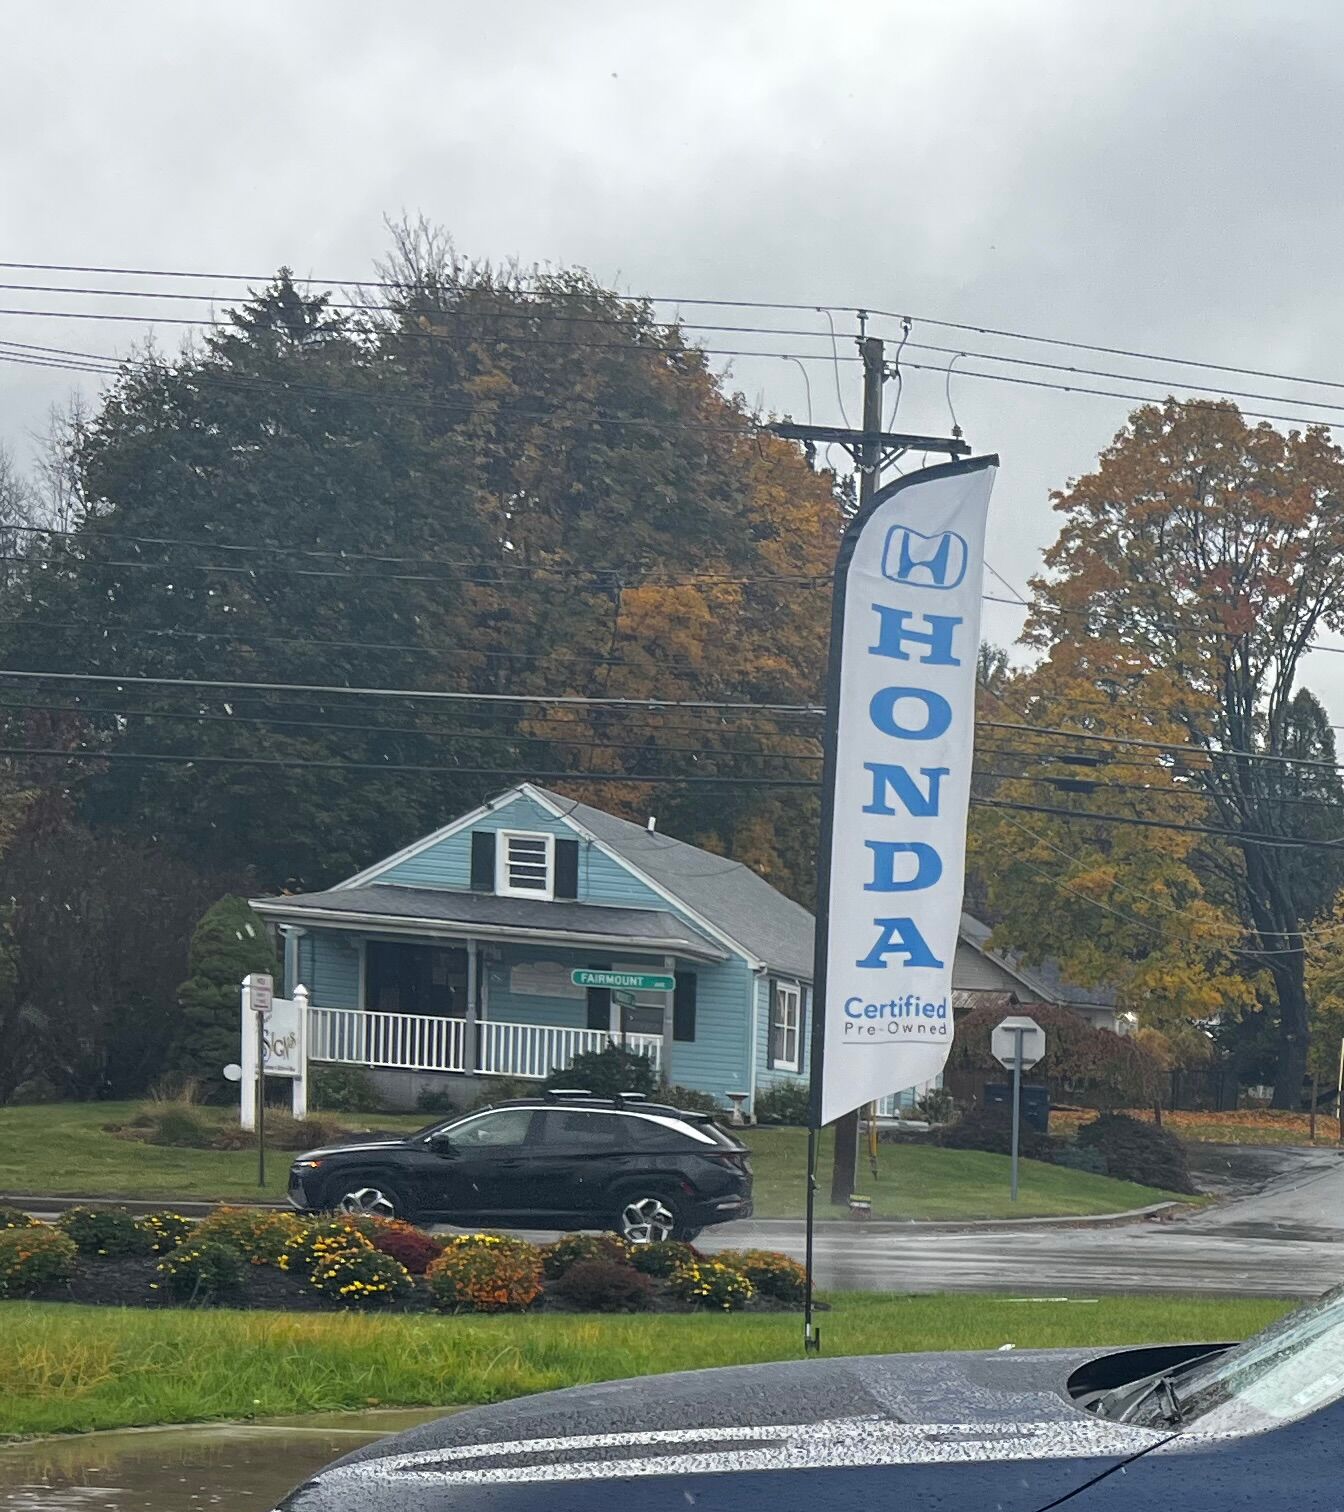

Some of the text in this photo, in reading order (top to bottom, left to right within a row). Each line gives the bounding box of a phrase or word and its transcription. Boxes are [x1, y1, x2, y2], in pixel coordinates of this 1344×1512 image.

[855, 602, 963, 969] HONDA
[581, 973, 644, 986] FAIRMOUNT
[844, 994, 947, 1019] Certified
[844, 1021, 947, 1036] Pre-Owned
